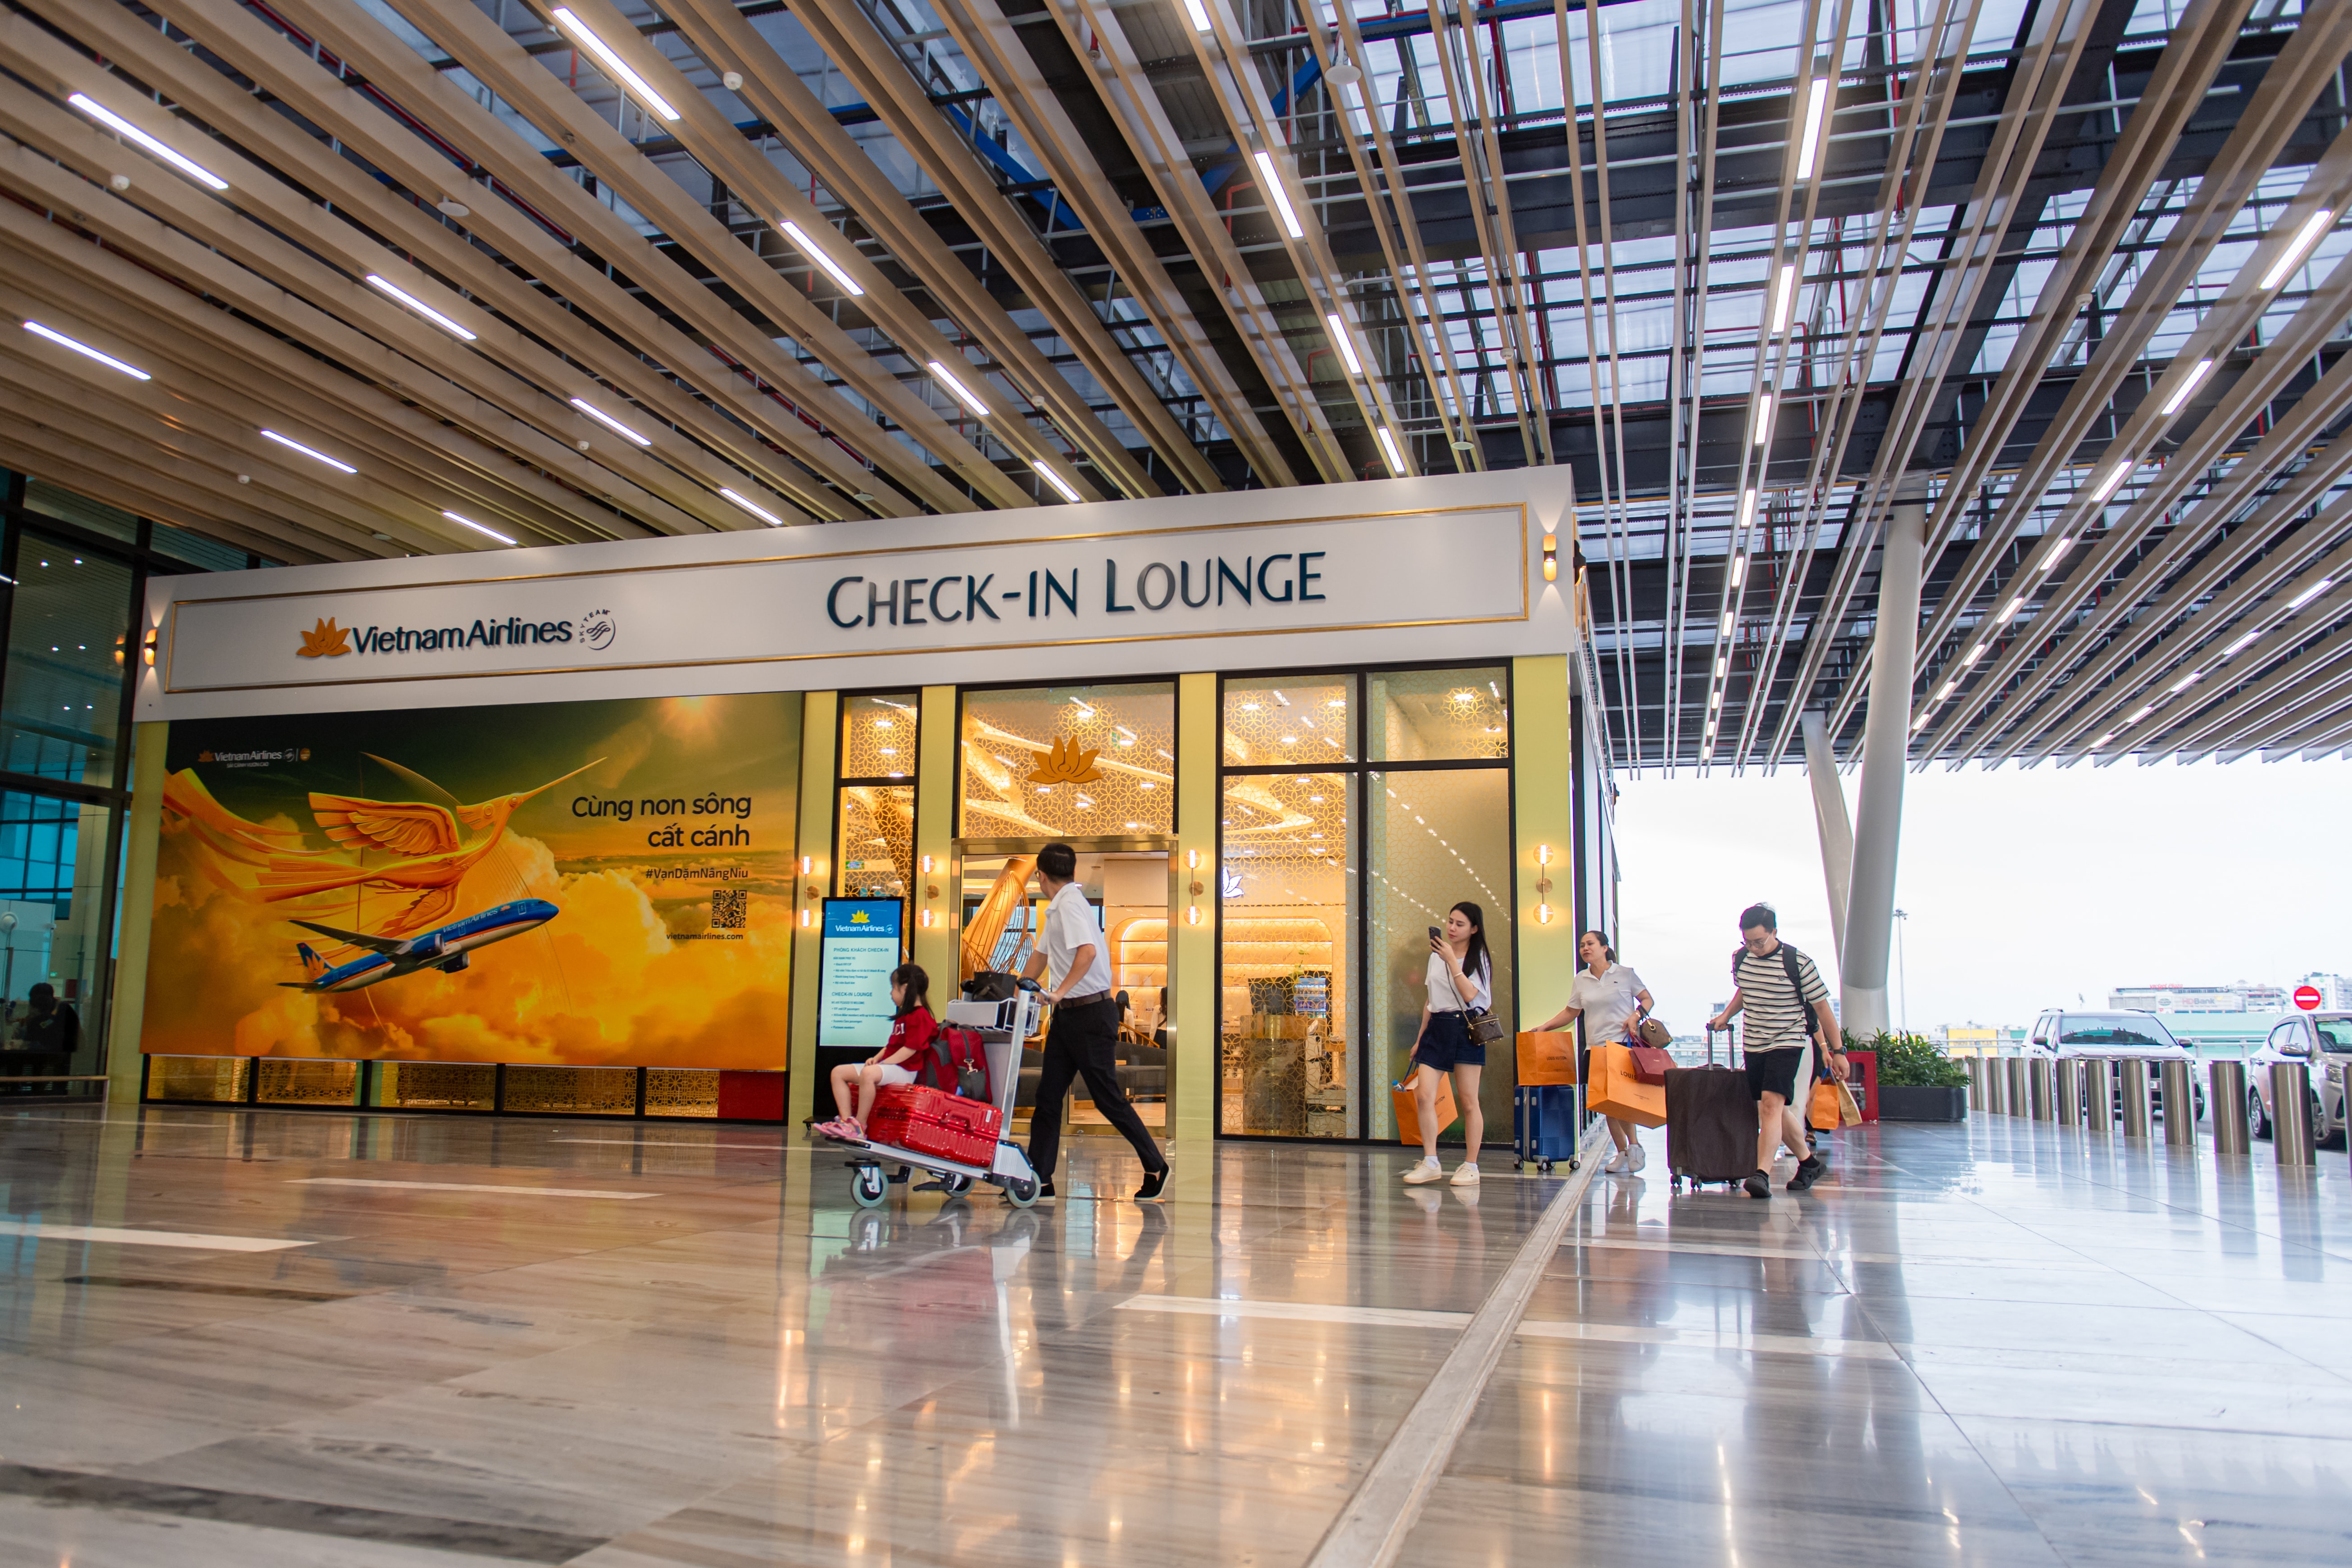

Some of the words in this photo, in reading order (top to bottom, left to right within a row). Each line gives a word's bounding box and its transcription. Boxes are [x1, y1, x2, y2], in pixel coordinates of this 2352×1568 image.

[827, 567, 1078, 628] CHECK-IN
[1105, 551, 1326, 612] LOUNGE
[353, 626, 463, 654] Vietnam
[466, 617, 572, 646] Airlines
[215, 752, 250, 761] Vietnam
[251, 750, 282, 760] Airlines
[572, 795, 633, 821] Cùng
[640, 798, 685, 815] non
[692, 792, 751, 819] sông
[648, 823, 684, 847] cất
[690, 824, 750, 846] cánh
[645, 868, 748, 881] #VạnDặmNângNiu
[443, 920, 471, 933] Vietnam
[470, 909, 498, 923] Airlines
[1620, 1070, 1637, 1080] LOUIS
